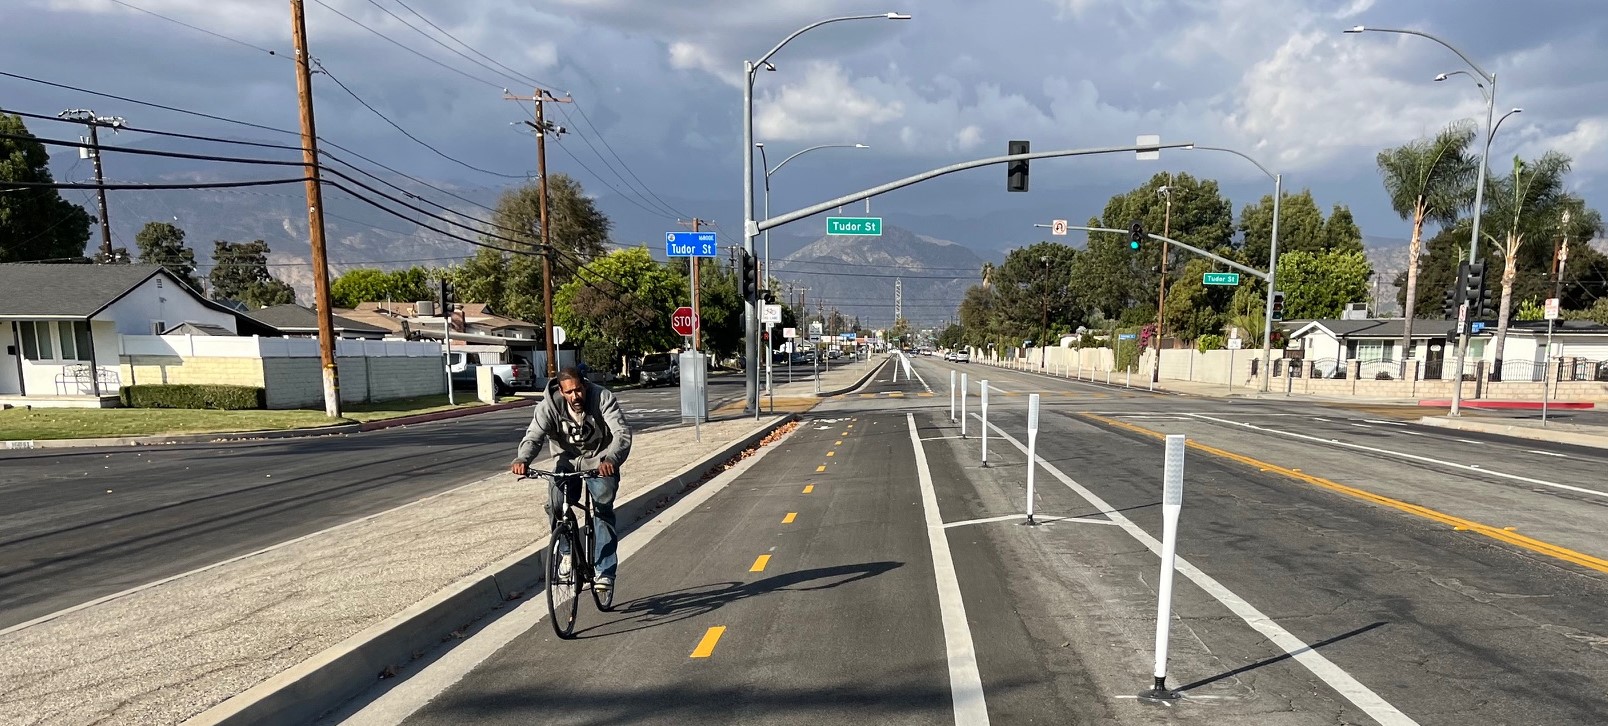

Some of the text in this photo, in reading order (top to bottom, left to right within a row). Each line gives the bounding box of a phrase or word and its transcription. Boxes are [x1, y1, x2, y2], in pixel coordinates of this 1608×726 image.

[833, 221, 876, 231] Tudor St
[671, 243, 712, 255] Tudor St
